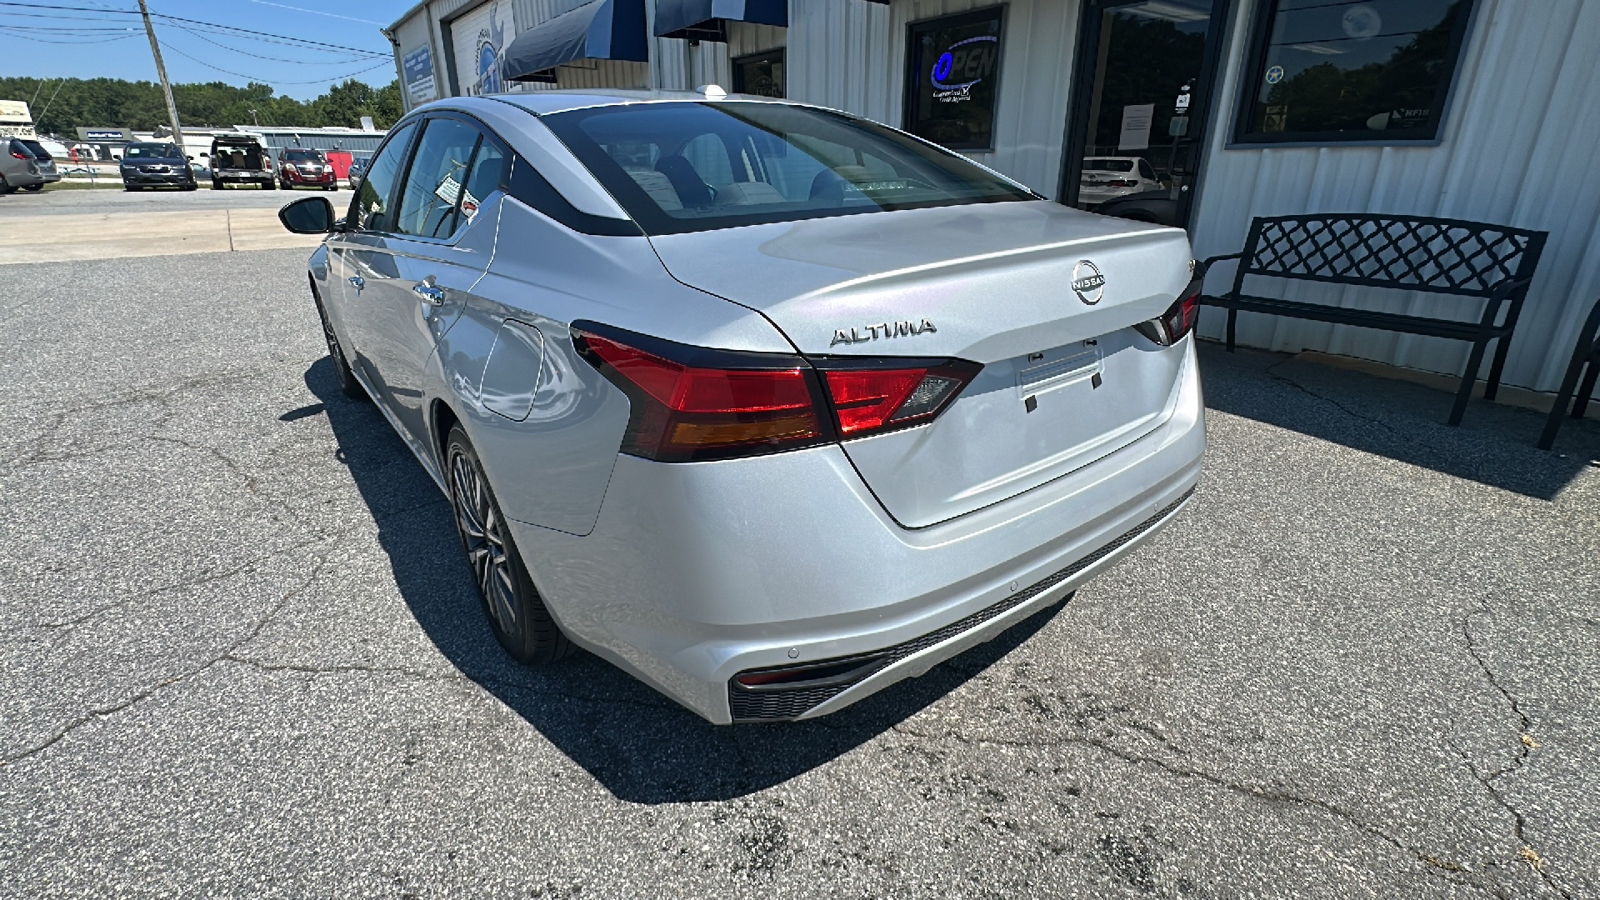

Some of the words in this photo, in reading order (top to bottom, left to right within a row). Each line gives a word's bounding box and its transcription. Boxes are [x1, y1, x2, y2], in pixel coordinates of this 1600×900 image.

[935, 46, 996, 80] OPEN
[1073, 276, 1104, 289] NISSAN
[830, 318, 937, 347] ALTIMA
